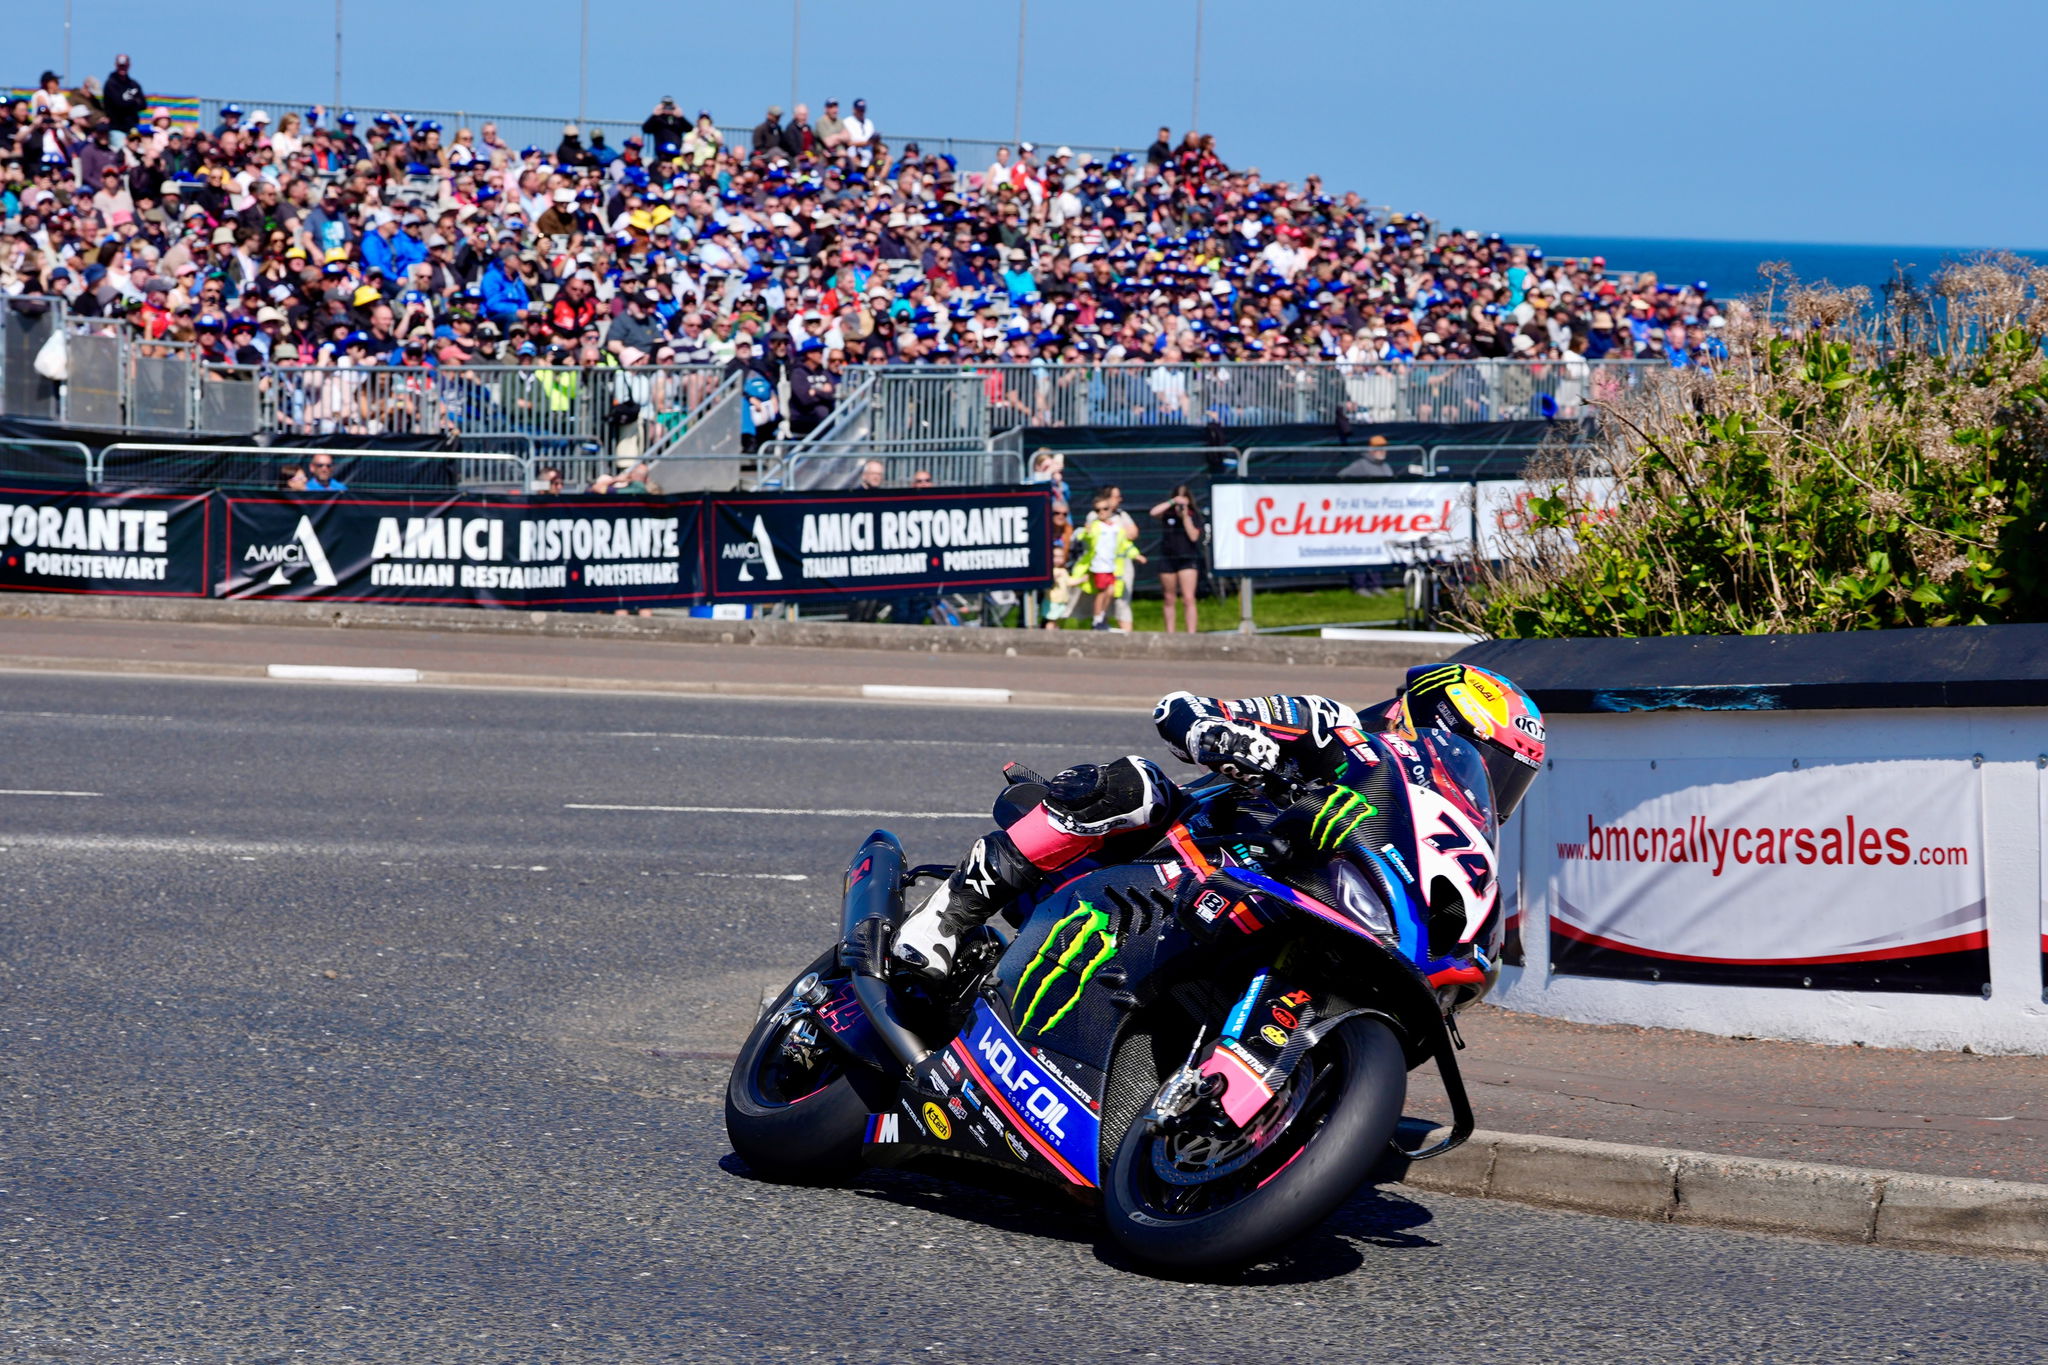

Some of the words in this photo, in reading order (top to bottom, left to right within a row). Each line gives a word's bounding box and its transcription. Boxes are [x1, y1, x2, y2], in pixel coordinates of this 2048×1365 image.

[801, 511, 875, 554] AMICI
[881, 507, 1029, 550] RISTORANTE
[1237, 498, 1452, 537] Schimmel
[244, 544, 303, 563] AMICI
[371, 517, 503, 560] AMICI
[520, 518, 679, 560] RISTORANTE
[722, 543, 760, 560] AMICI
[24, 552, 168, 580] PORTSTEWART
[371, 564, 456, 588] ITALIAN
[461, 565, 566, 589] RESTAURANT
[584, 562, 679, 587] PORTSTEWART
[802, 557, 849, 579] ITALIAN
[851, 553, 927, 577] RESTAURANT
[943, 548, 1030, 572] PORTSTEWART
[1420, 809, 1490, 901] 74
[1557, 814, 1968, 877] www.bmcnallycarsales.com
[1233, 1044, 1268, 1074] SMITHS
[979, 1026, 1039, 1091] WOLF
[1026, 1086, 1069, 1139] OIL
[1008, 1091, 1061, 1146] CORPORATION
